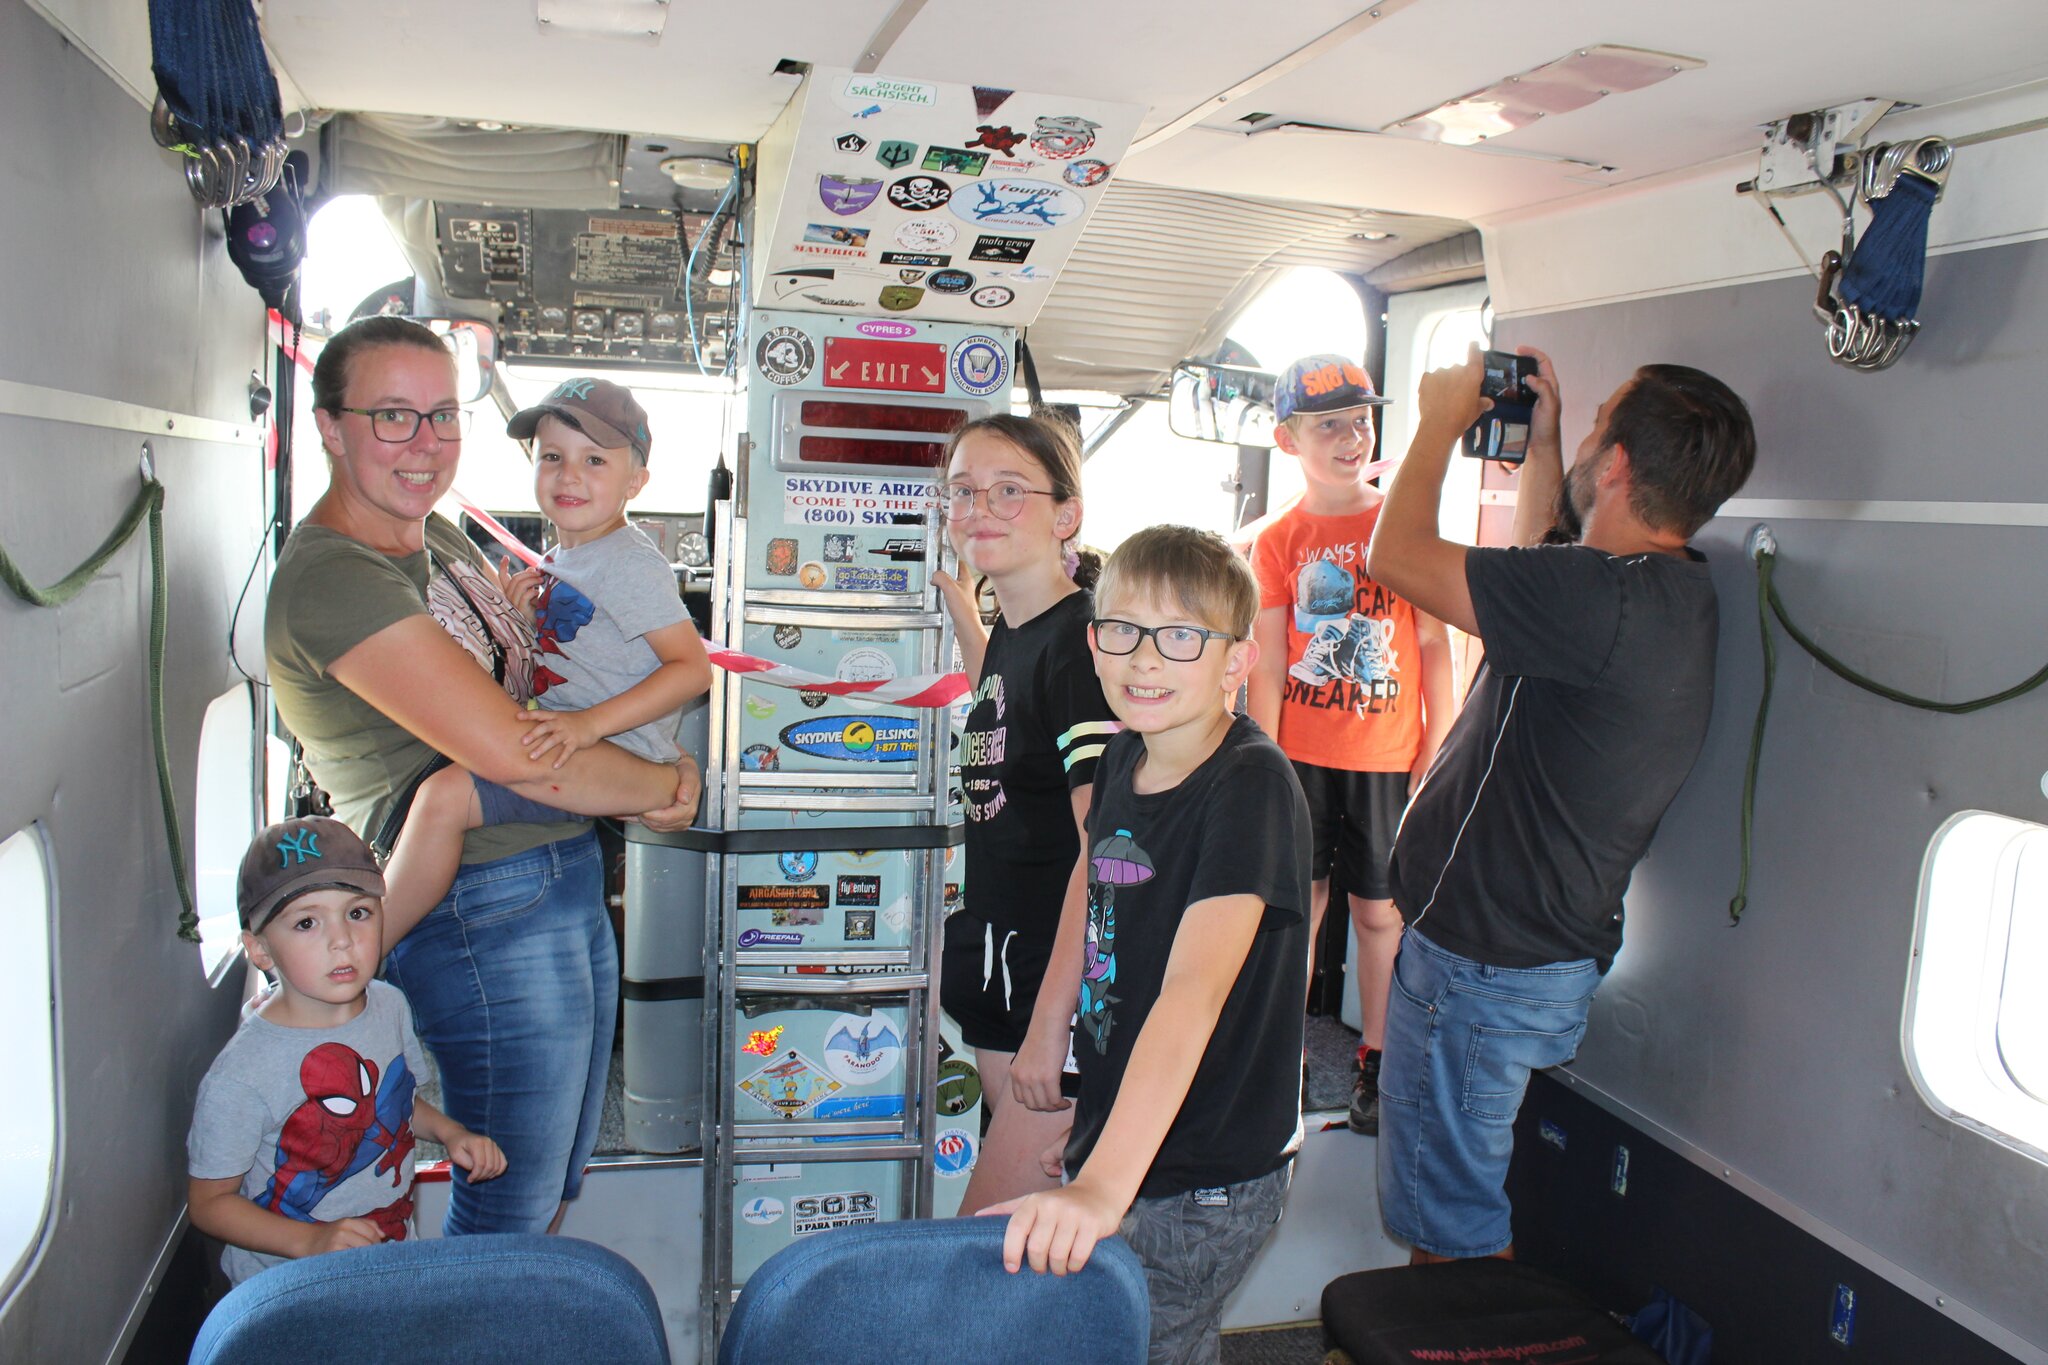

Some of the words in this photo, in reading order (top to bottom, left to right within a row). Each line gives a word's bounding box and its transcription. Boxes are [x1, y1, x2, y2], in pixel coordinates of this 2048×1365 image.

[894, 82, 922, 93] GEHT
[851, 86, 929, 104] SÄCHSISCH.
[890, 187, 902, 198] B
[932, 190, 950, 202] 12
[793, 245, 869, 258] MAVERICK
[862, 324, 902, 334] CYPRES
[904, 327, 911, 335] 2
[967, 338, 997, 349] MEMBER
[767, 372, 802, 385] COFFEE
[861, 361, 910, 384] EXIT
[786, 479, 873, 495] SKYDIVE
[852, 499, 877, 508] TO
[883, 500, 918, 510] THE
[804, 509, 855, 525] (800)
[794, 731, 843, 745] SKYDIVE
[875, 742, 898, 753] 1-877
[759, 934, 801, 942] FREEFALL
[796, 1194, 876, 1217] SOR
[805, 1221, 830, 1231] PARA
